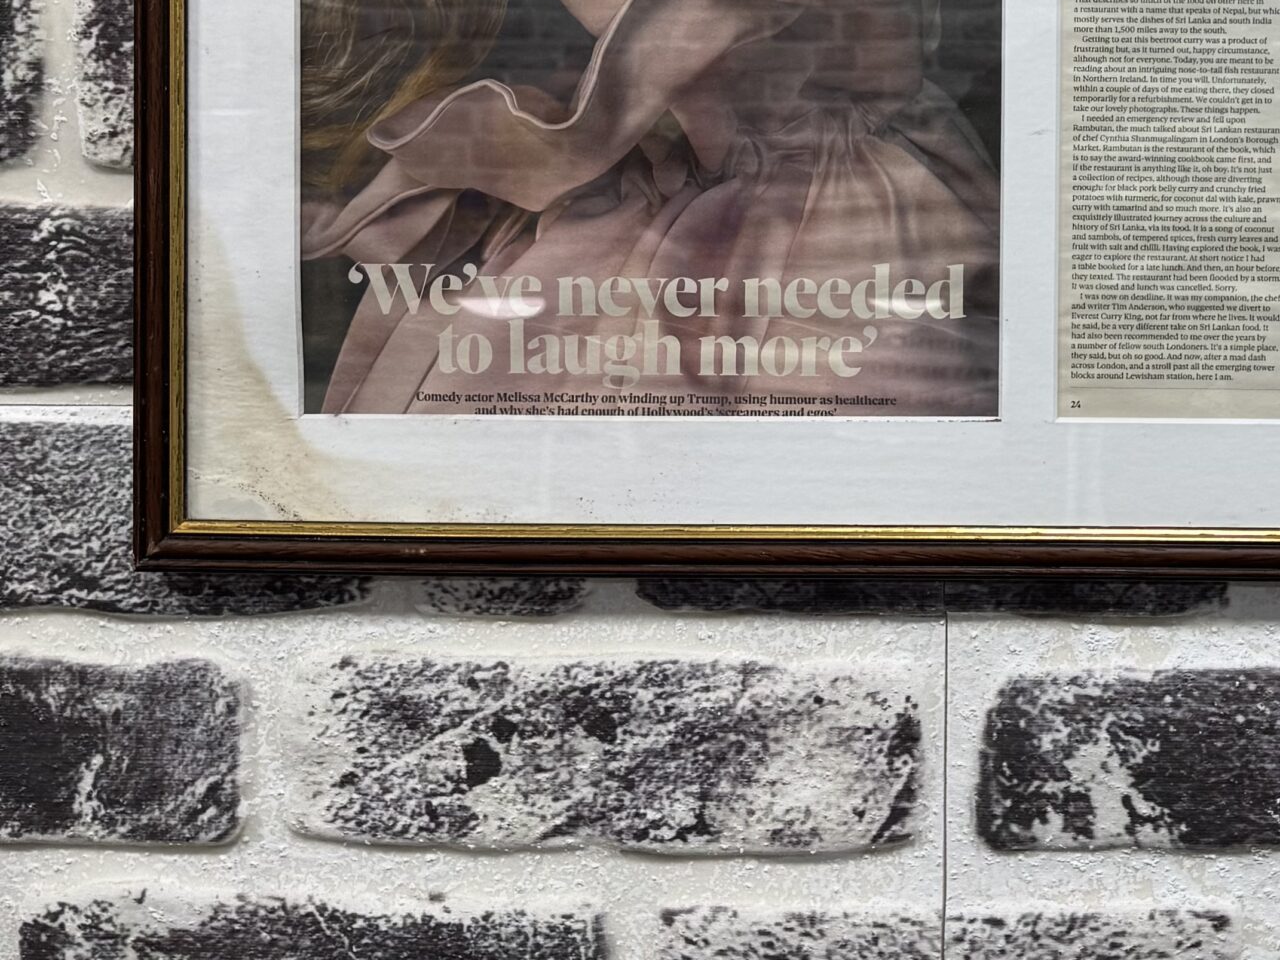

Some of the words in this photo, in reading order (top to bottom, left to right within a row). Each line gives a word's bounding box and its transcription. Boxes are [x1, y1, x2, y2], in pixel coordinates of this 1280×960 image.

[556, 274, 729, 318] never
[741, 263, 967, 320] needed
[437, 323, 493, 375] to
[506, 319, 683, 389] laugh
[415, 391, 463, 404] Comedy
[464, 393, 495, 403] actor
[497, 392, 541, 403] Melissa
[543, 393, 599, 406] McCarthy
[601, 395, 617, 404] on
[618, 393, 667, 407] winding
[670, 396, 686, 407] up
[687, 393, 732, 407] Trump,
[734, 395, 768, 407] using
[768, 395, 818, 405] humour
[819, 397, 833, 406] as
[834, 395, 897, 406] healthcare
[1070, 400, 1082, 409] 24
